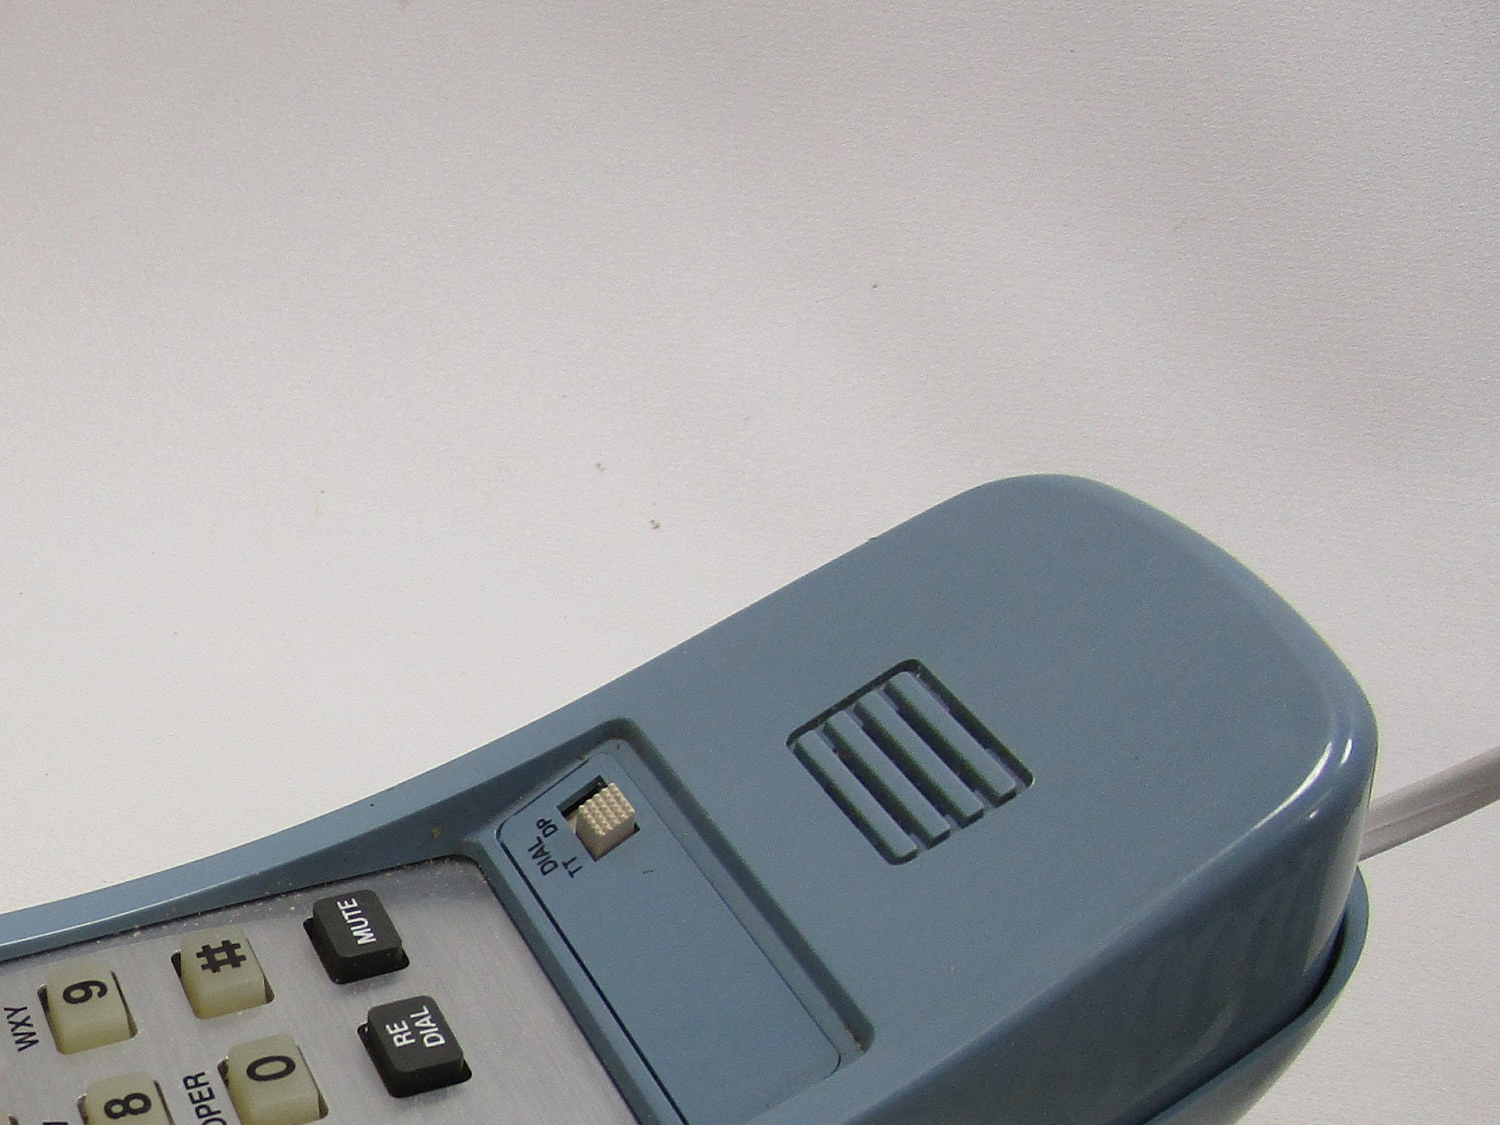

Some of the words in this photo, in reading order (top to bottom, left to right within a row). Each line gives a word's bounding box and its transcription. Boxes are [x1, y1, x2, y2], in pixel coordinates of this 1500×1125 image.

[537, 818, 558, 838] DP
[528, 836, 558, 875] DIAL
[562, 856, 582, 878] TT
[338, 897, 377, 945] MUTE
[196, 940, 246, 973] #
[62, 980, 108, 1004] 9
[4, 1006, 39, 1052] WXY
[386, 1021, 415, 1048] RE
[410, 1005, 445, 1048] DIAL
[246, 1055, 295, 1082] 0
[104, 1093, 152, 1119] 8
